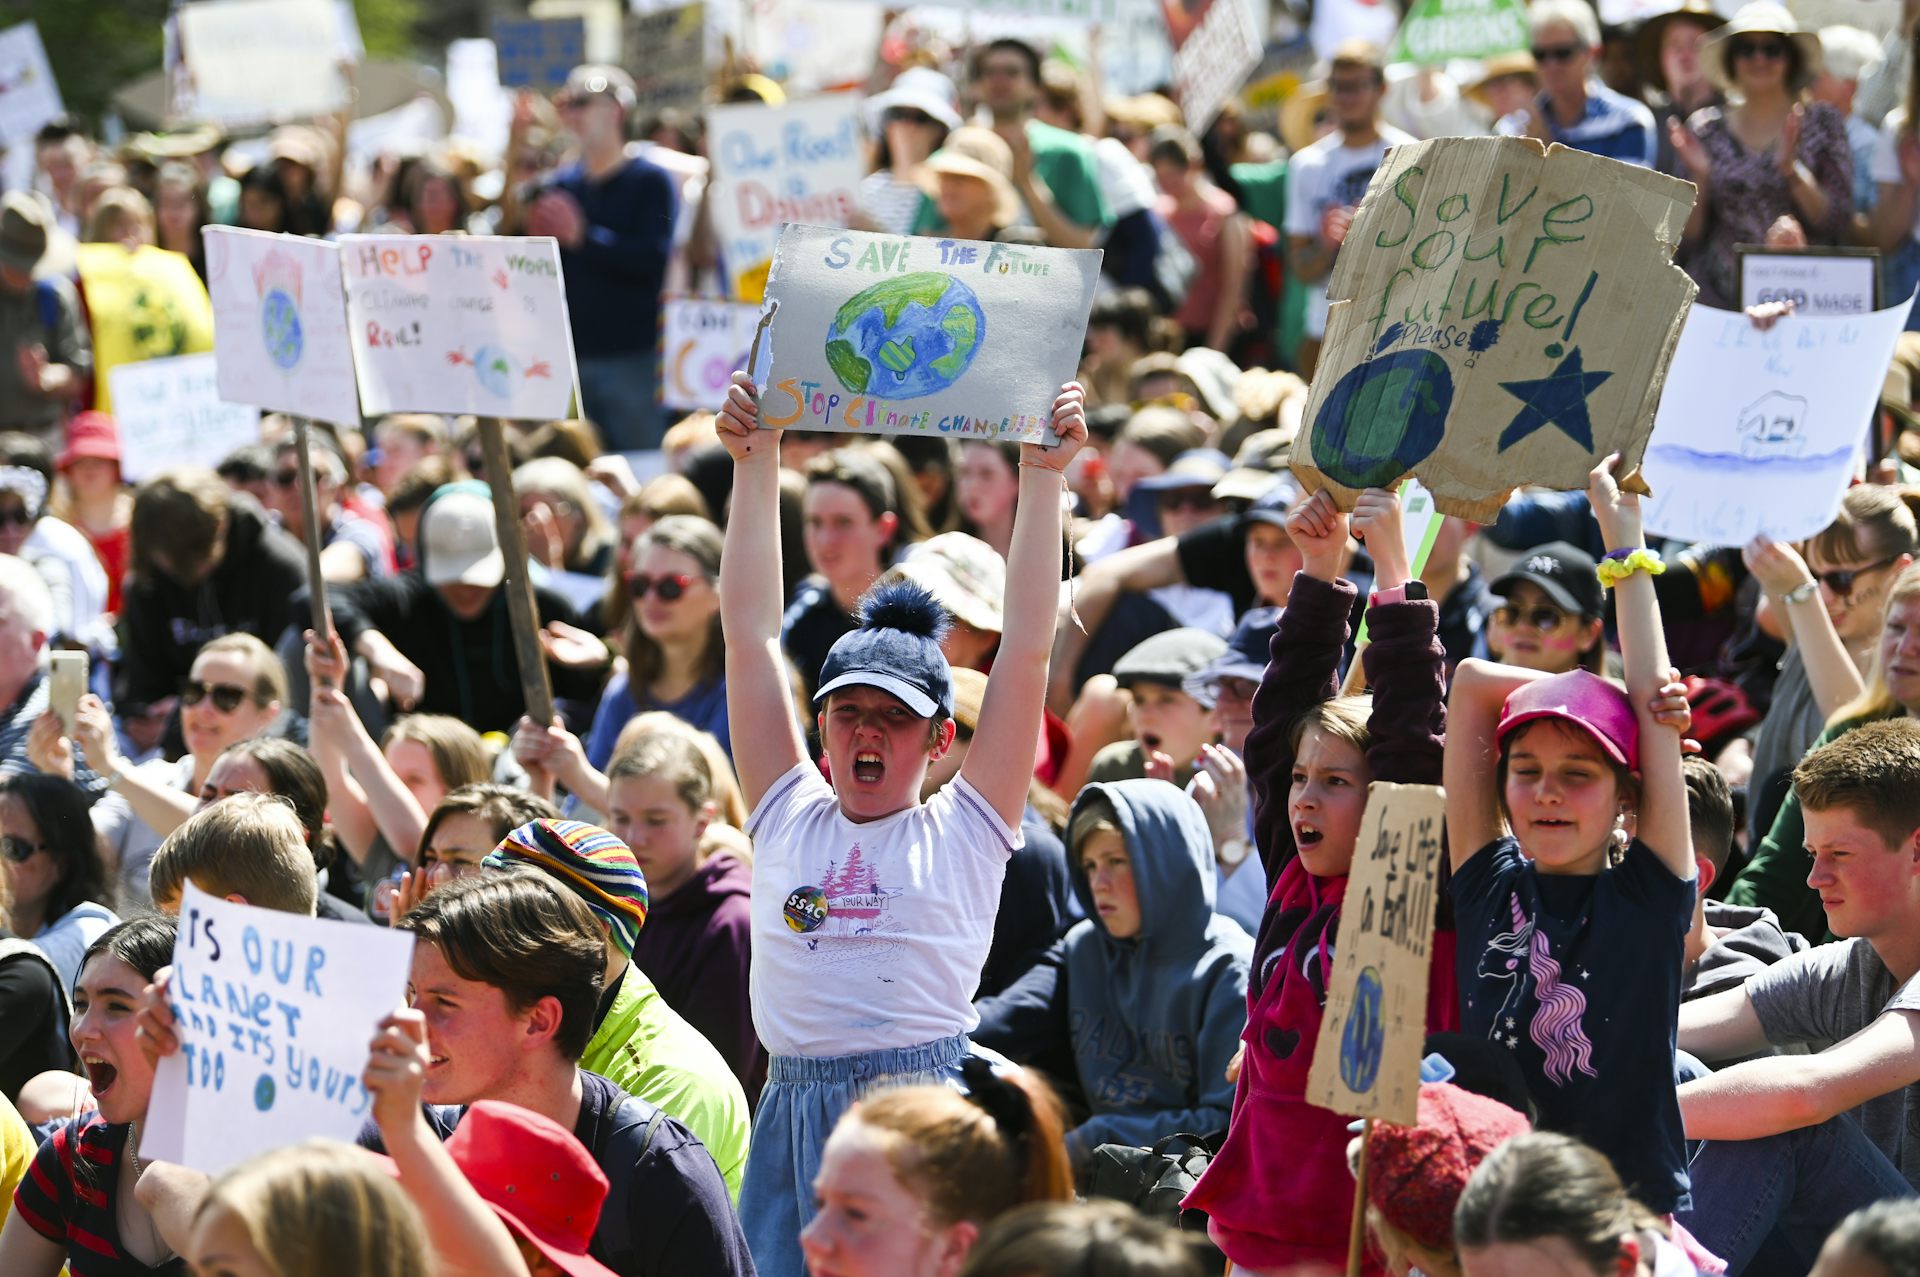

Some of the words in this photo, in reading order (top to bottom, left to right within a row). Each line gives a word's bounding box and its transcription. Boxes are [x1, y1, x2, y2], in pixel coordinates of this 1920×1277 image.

[1375, 166, 1594, 248] Save
[824, 238, 912, 273] SAVE
[936, 239, 979, 265] THE
[1411, 230, 1561, 274] our
[1368, 267, 1599, 359] future!
[787, 894, 825, 919] SS4C
[841, 895, 862, 909] YOUR
[865, 895, 886, 908] WAY
[242, 925, 326, 997] OUR
[181, 1042, 224, 1092] TOO
